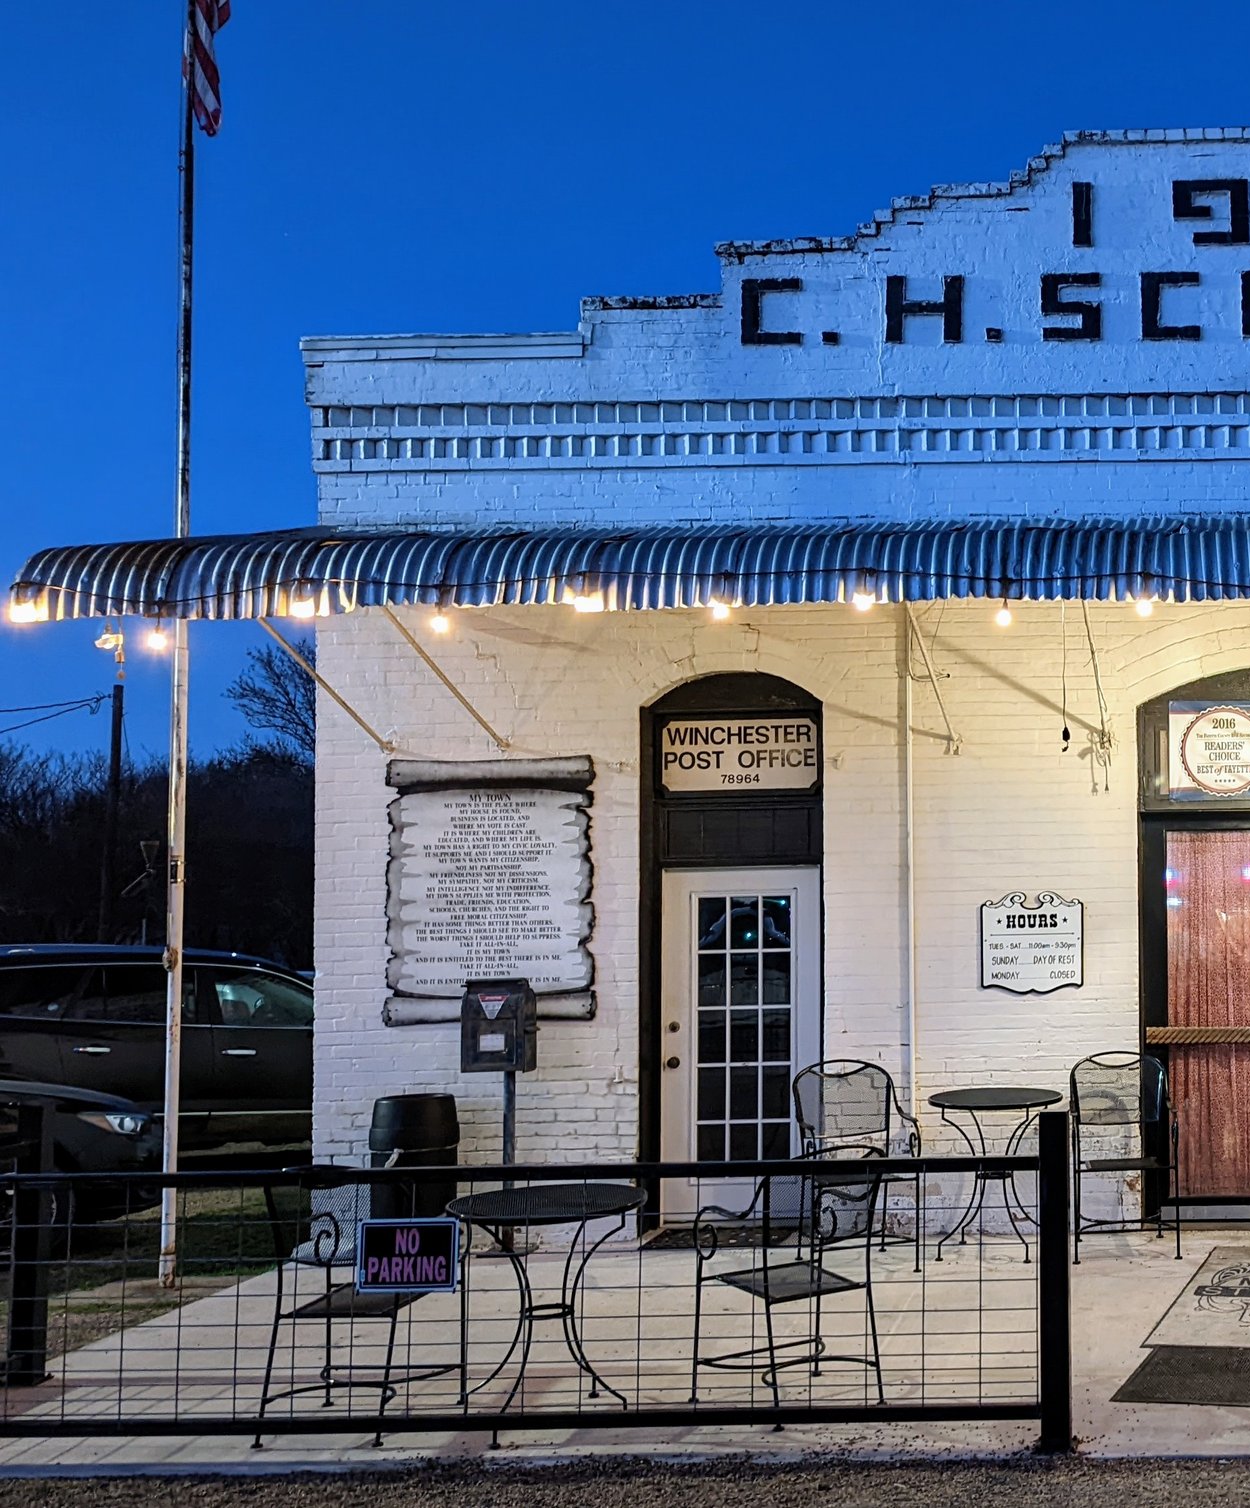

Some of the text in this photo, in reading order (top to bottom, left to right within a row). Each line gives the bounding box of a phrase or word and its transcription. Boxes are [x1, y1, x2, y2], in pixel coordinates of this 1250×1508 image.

[741, 277, 839, 345] C.
[885, 275, 1002, 344] H.
[1212, 718, 1236, 729] 2016
[667, 724, 812, 746] WINCHESTER
[1204, 742, 1245, 750] READERS'
[664, 748, 816, 770] POST OFFICE
[1208, 752, 1241, 761] CHOICE
[1197, 766, 1214, 774] BEST
[1214, 765, 1224, 776] of
[720, 774, 760, 784] 78964
[1006, 914, 1058, 928] HOURS
[992, 954, 1075, 966] SUNDAY DAY OF REST
[991, 970, 1076, 980] MONDAY CLOSED
[395, 1228, 420, 1255] NO
[367, 1256, 447, 1282] PARKING
